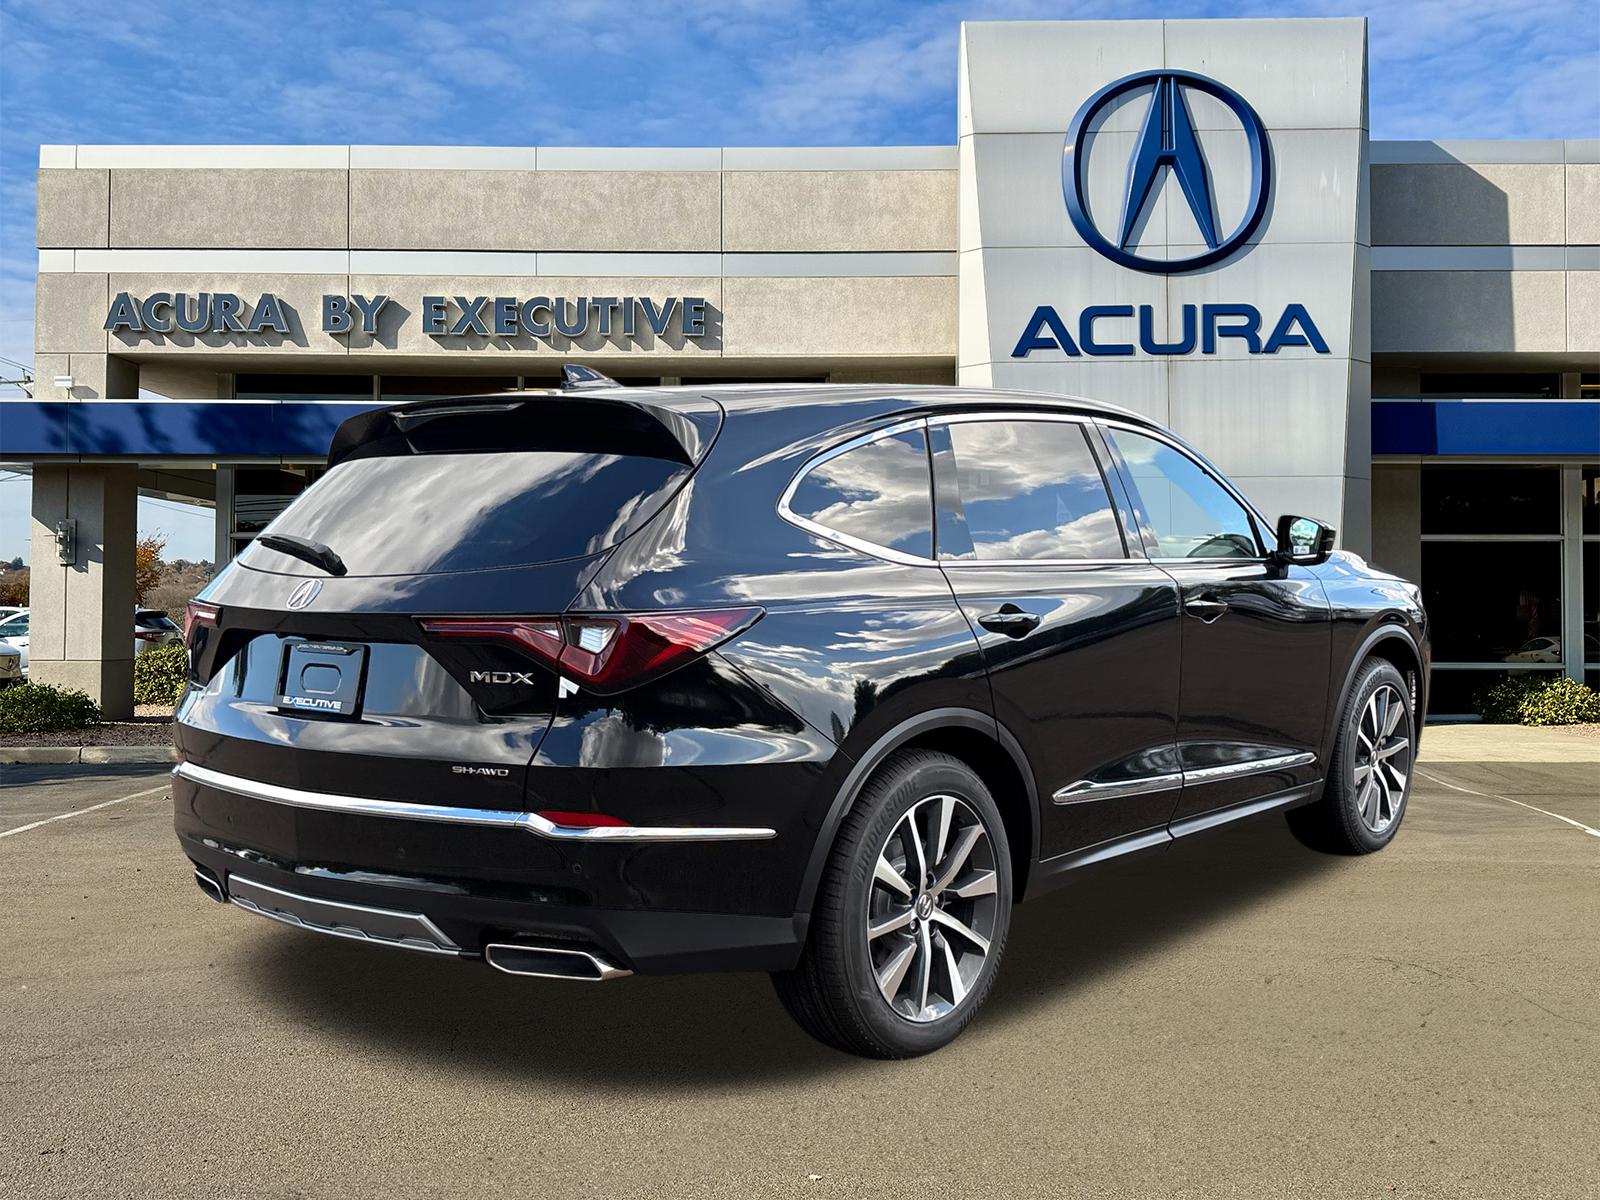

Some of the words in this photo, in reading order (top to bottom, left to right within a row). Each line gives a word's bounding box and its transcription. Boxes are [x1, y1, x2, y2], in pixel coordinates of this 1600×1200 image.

[103, 291, 290, 334] ACURA
[321, 294, 392, 334] BY
[422, 295, 707, 337] EXECUTIVE
[1011, 303, 1332, 357] ACURA
[469, 670, 534, 685] MDX
[283, 695, 342, 709] EXECUTIVE
[451, 765, 510, 777] SH-AWD
